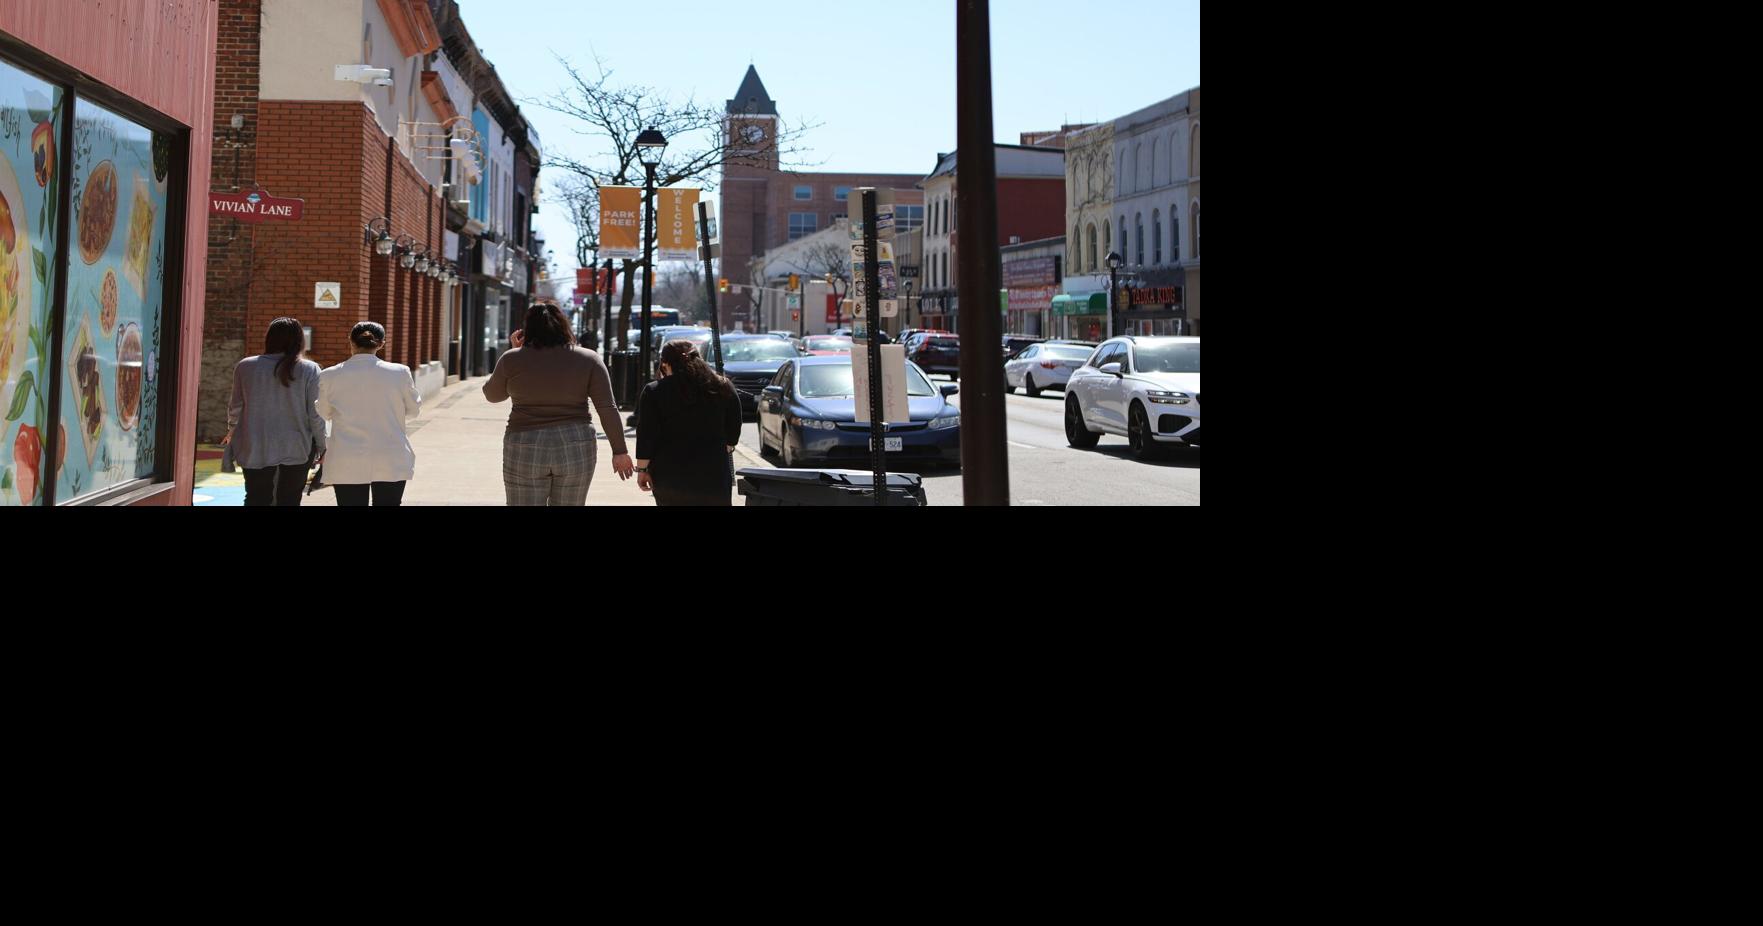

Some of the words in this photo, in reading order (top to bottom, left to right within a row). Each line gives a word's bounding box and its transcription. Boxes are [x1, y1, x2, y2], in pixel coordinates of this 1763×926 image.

[213, 200, 255, 213] VIVIAN
[260, 204, 292, 216] LANE
[604, 210, 635, 218] PARK
[603, 218, 635, 226] FREE!
[672, 189, 684, 244] WELCOME
[1132, 287, 1154, 304] TADKA
[1157, 286, 1176, 303] KING
